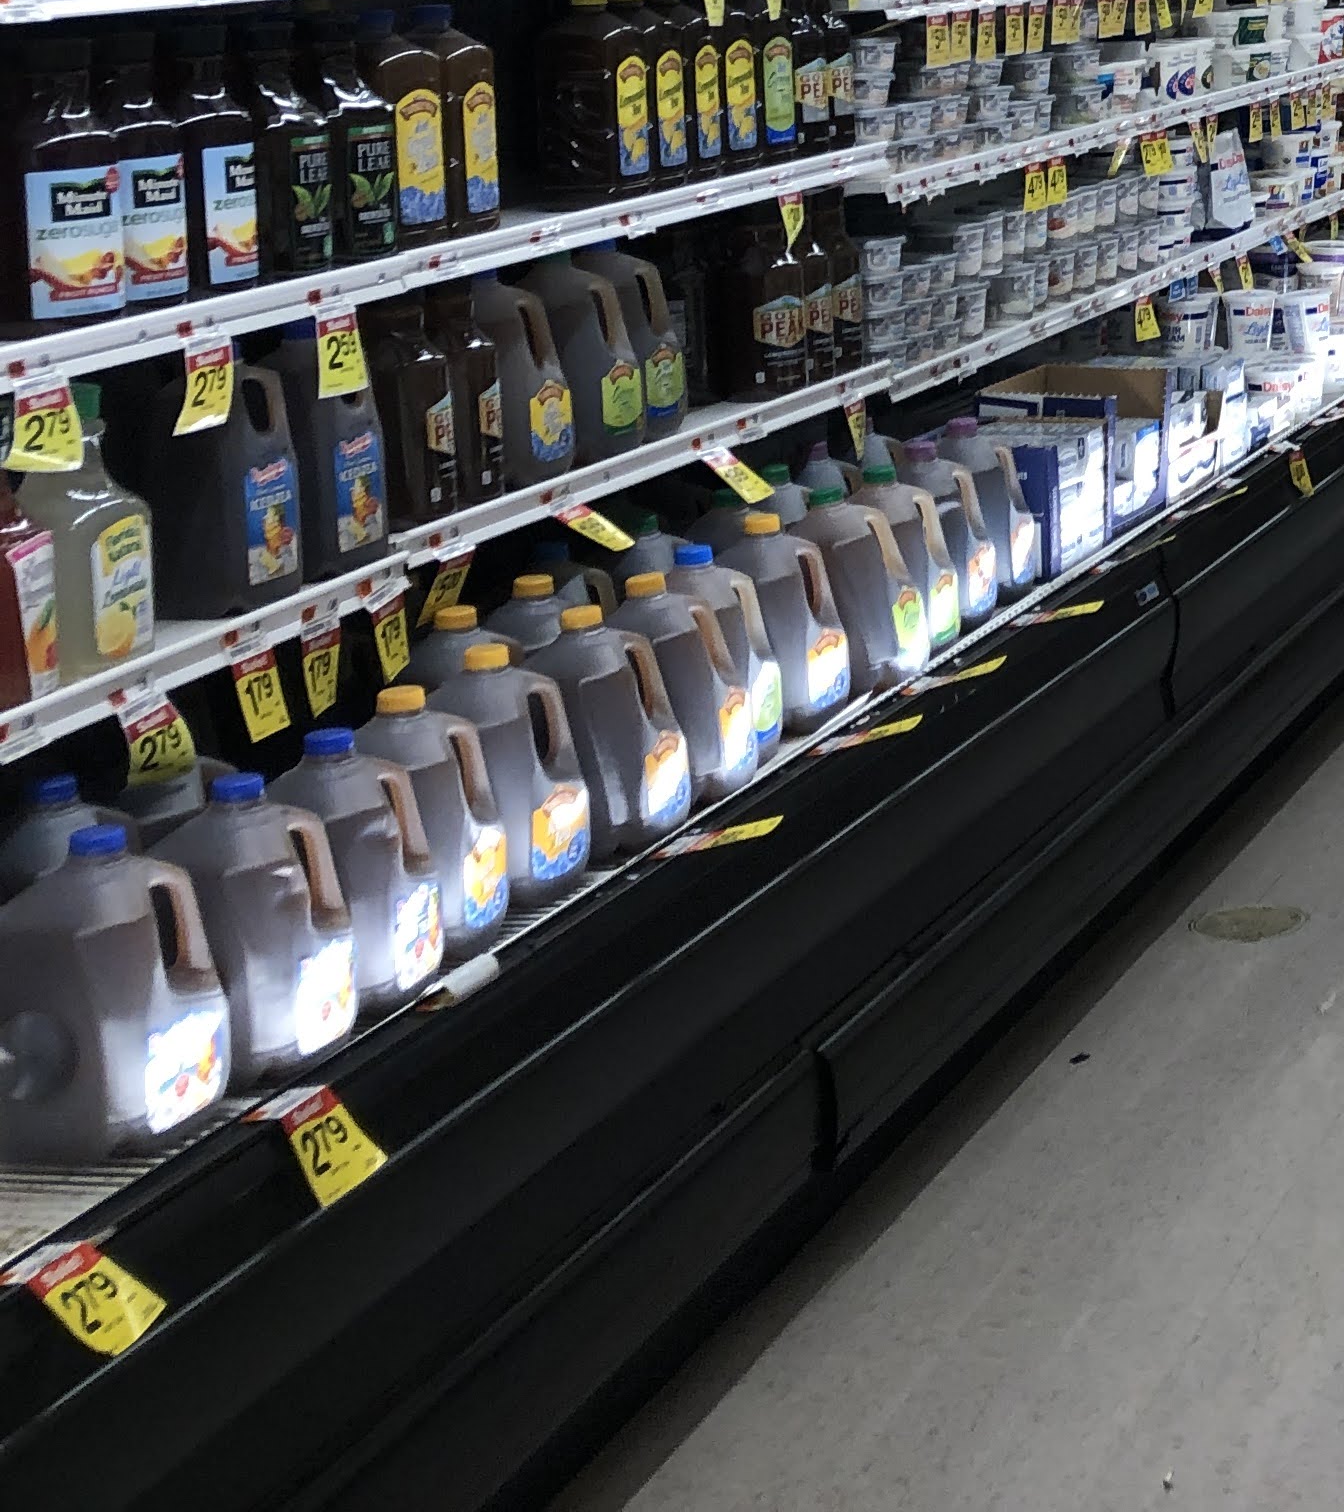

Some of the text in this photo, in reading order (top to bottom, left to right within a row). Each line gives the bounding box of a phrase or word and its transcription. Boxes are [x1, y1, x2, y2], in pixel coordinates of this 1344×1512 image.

[356, 140, 391, 157] PURE
[56, 190, 107, 205] Minute
[64, 201, 104, 217] Maid
[145, 189, 177, 202] Maid
[191, 366, 227, 408] 279
[24, 407, 70, 452] 279
[244, 672, 274, 717] 179
[138, 726, 183, 773] 279
[299, 1116, 348, 1176] 279
[60, 1271, 119, 1335] 279
